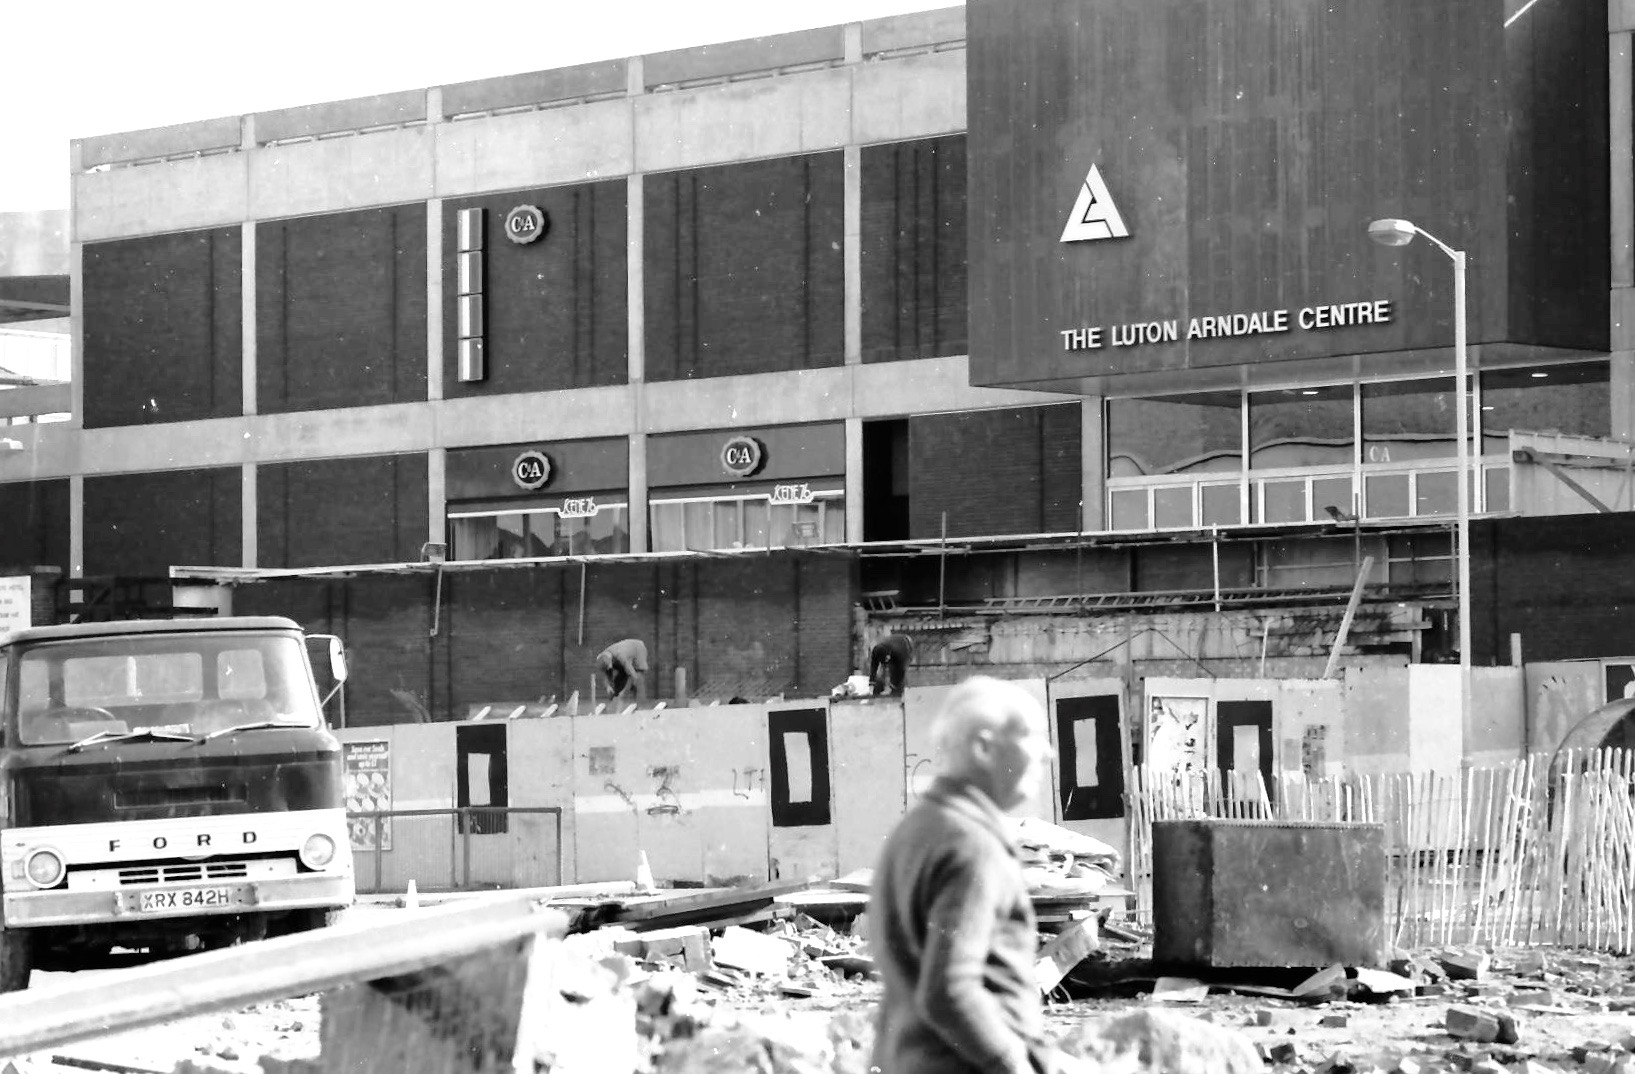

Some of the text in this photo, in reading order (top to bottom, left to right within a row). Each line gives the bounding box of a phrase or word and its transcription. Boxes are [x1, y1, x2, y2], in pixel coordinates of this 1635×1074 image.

[1061, 300, 1390, 350] THE LUTON ARNDALE CENTRE
[727, 447, 751, 464] C&A
[109, 831, 257, 852] FORD
[144, 890, 229, 908] XRX 842H
